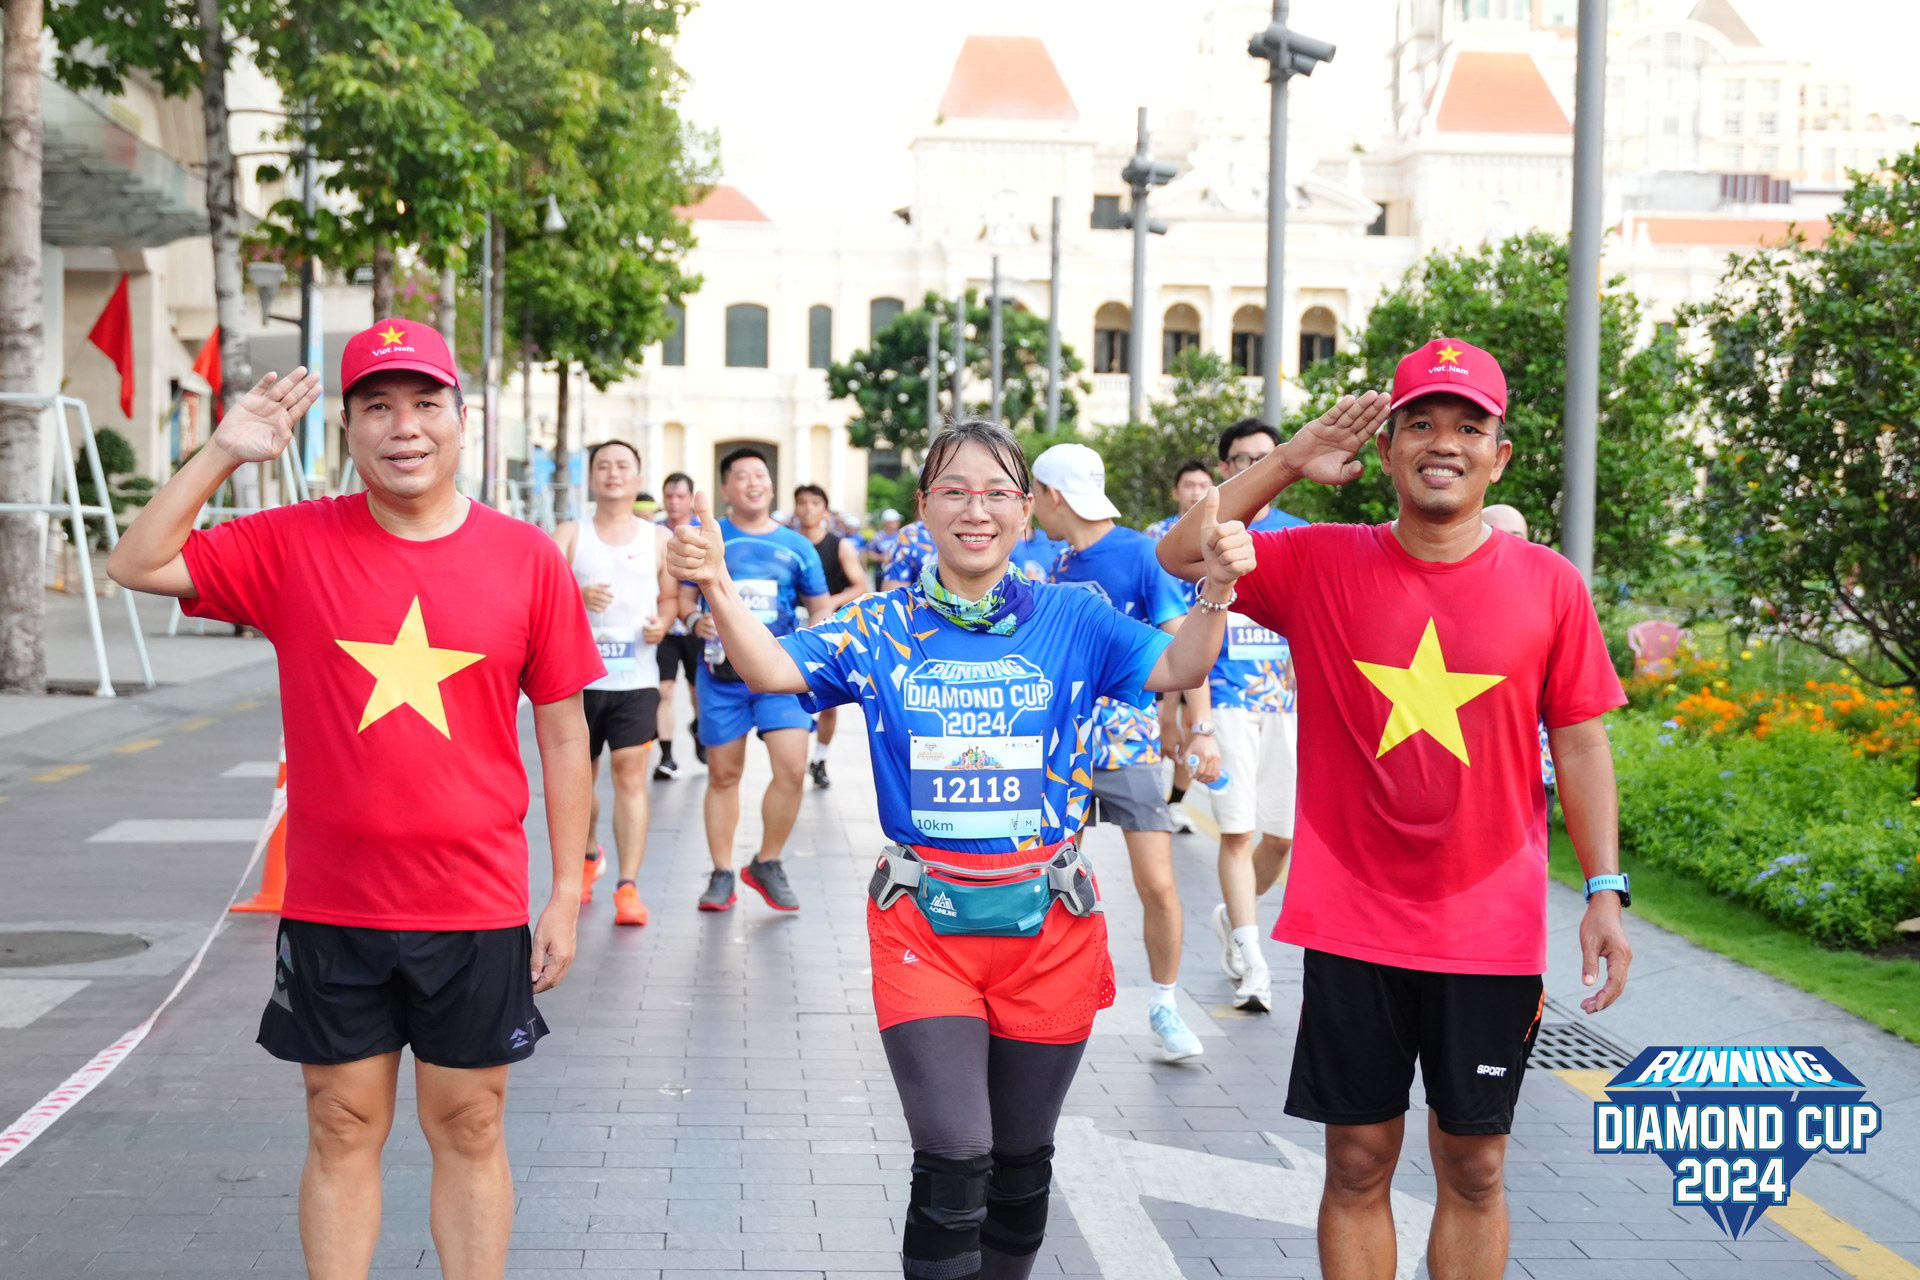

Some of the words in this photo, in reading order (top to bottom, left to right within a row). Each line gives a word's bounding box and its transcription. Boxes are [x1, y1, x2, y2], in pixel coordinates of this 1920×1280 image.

[1448, 365, 1469, 376] Nam
[929, 659, 1027, 681] RUNNING
[908, 684, 1004, 708] DIAMOND
[1010, 683, 1050, 707] CUP
[947, 711, 1007, 735] 2024
[932, 776, 1021, 803] 12118
[917, 819, 954, 831] 10km
[1476, 1064, 1507, 1077] SPORT
